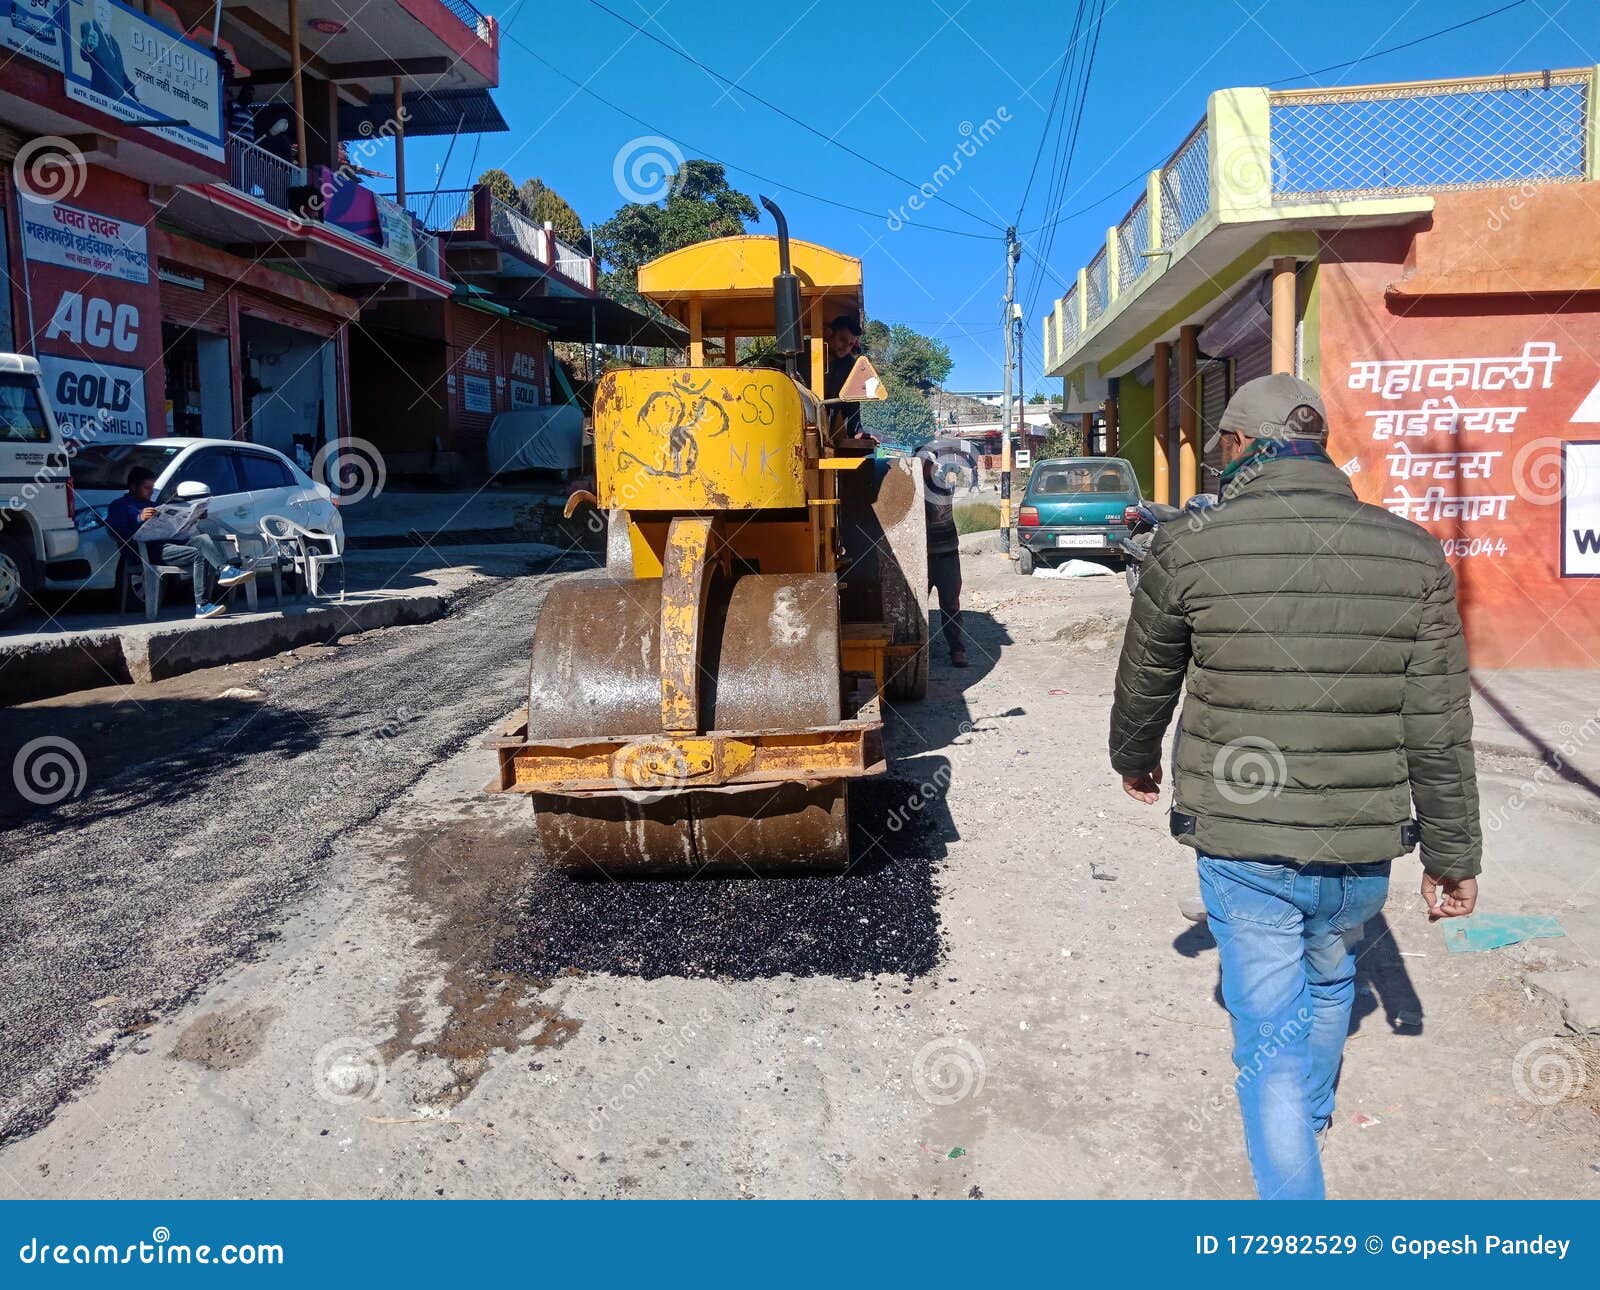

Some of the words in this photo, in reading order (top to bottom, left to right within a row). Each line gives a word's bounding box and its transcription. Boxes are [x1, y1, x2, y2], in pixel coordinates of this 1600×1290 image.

[89, 93, 108, 108] DEALER
[53, 205, 85, 230] रावत
[25, 220, 75, 249] महाकाली
[45, 291, 139, 352] ACC
[511, 352, 536, 380] ACC
[1348, 341, 1563, 400] महाकाली
[56, 370, 131, 412] GOLD
[514, 386, 534, 403] GOLD
[103, 416, 144, 436] SHIELD
[1441, 537, 1508, 558] 05044
